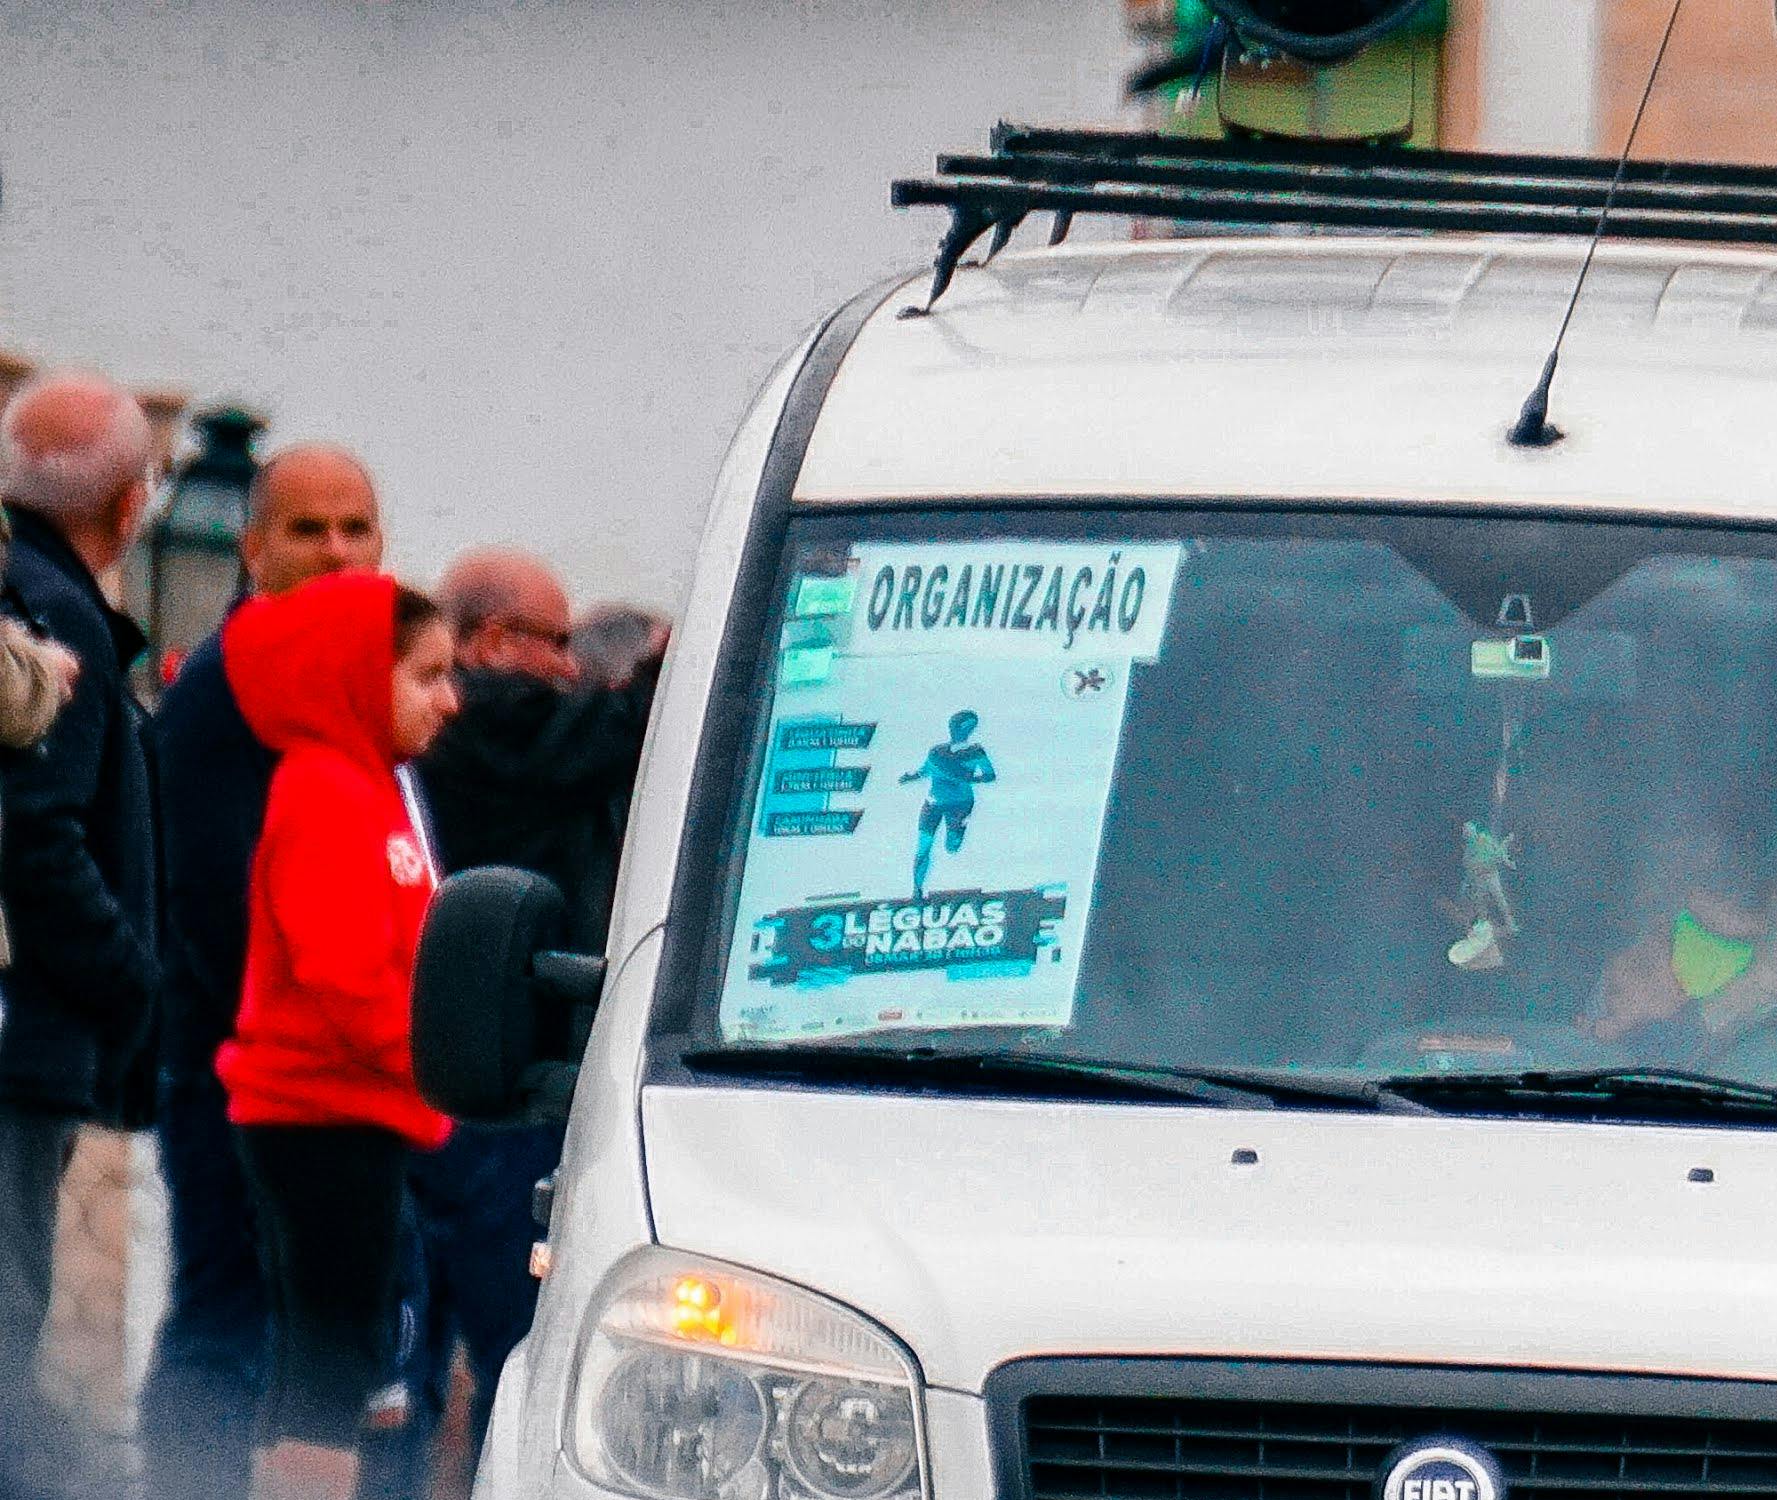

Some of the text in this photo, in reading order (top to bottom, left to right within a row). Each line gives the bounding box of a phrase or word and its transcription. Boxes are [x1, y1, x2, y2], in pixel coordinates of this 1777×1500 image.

[866, 551, 1146, 649] ORGANIZAÇÃO
[809, 900, 1007, 951] 3 LÉGUAS
